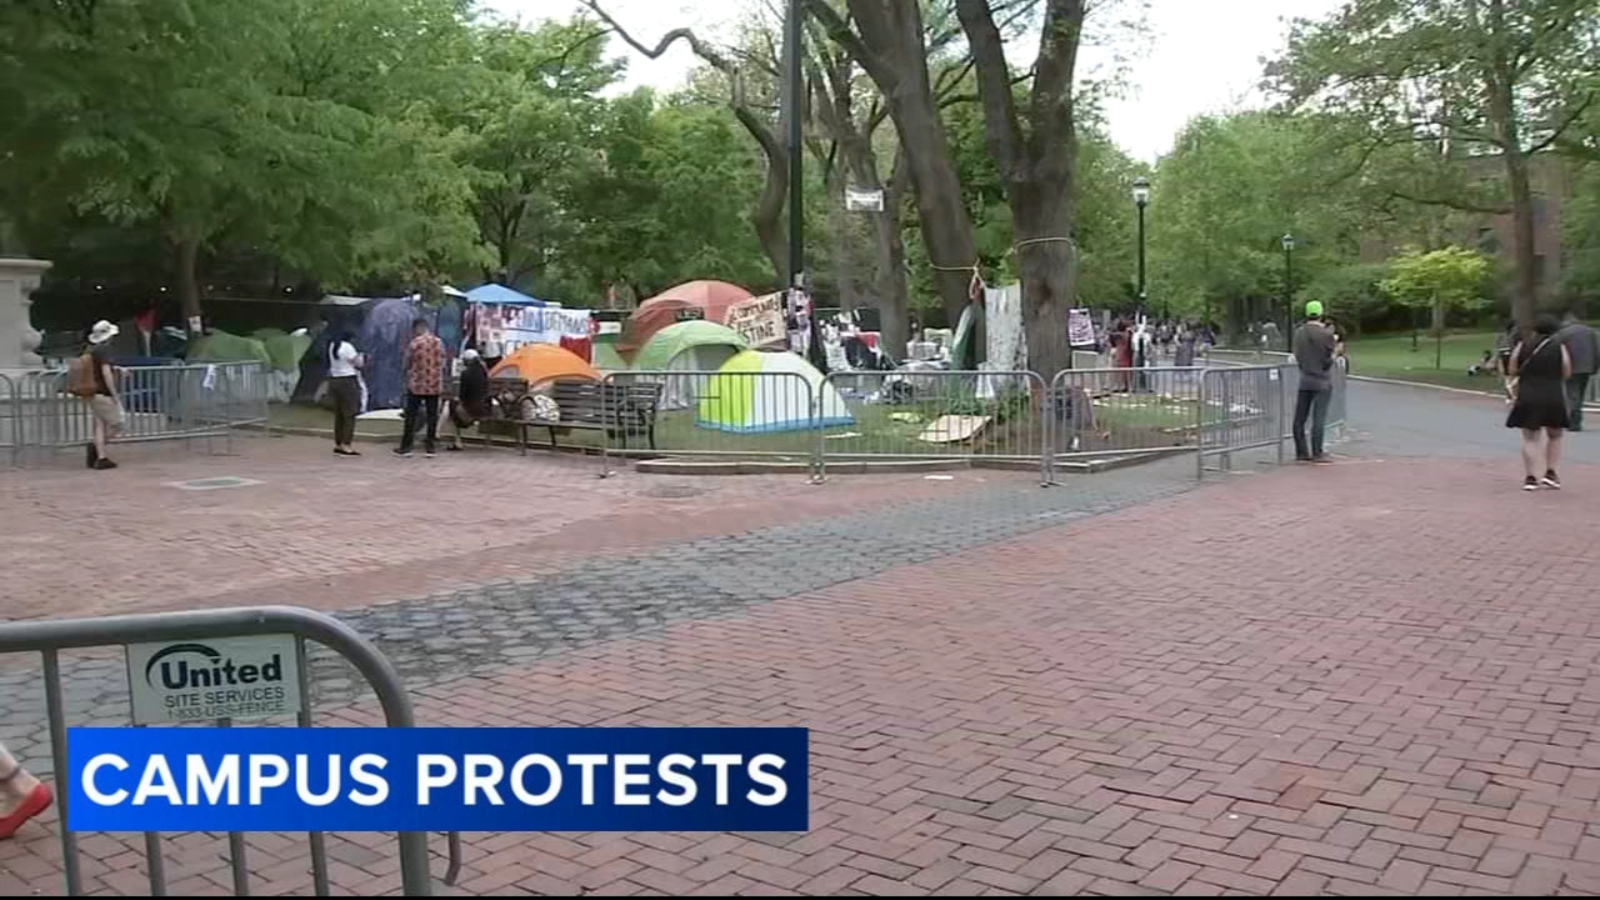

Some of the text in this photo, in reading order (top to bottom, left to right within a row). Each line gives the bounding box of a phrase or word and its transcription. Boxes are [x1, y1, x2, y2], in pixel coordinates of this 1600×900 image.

[161, 654, 282, 690] United
[165, 687, 285, 708] SITE SERVICES
